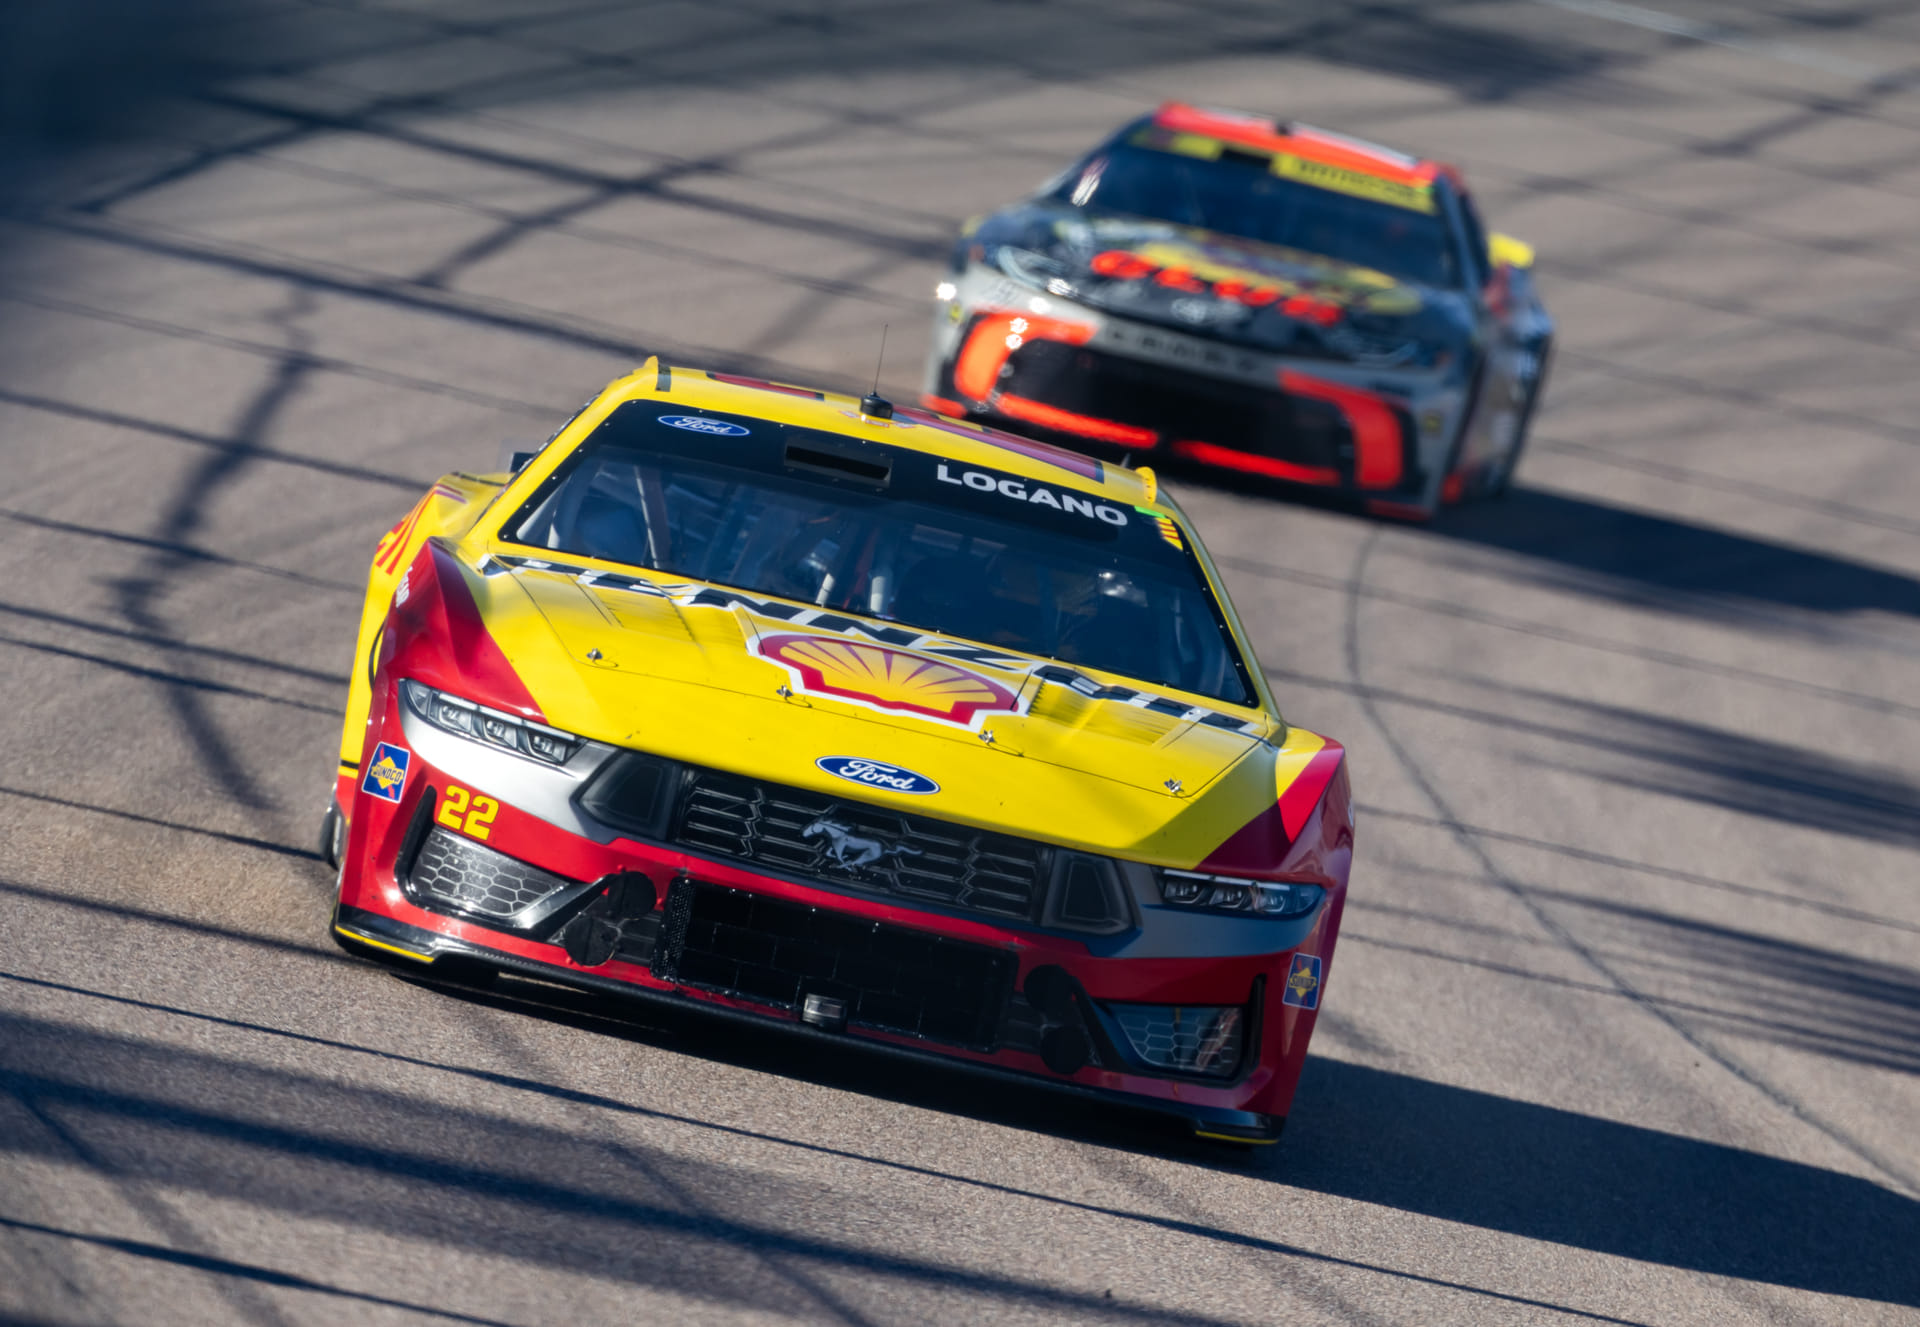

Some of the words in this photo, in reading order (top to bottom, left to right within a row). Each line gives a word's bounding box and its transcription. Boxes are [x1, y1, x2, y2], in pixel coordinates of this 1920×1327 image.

[674, 417, 732, 433] Ford
[937, 463, 1128, 526] LOGANO
[373, 763, 403, 783] SUNOCO
[839, 760, 916, 790] Ford
[437, 785, 500, 840] 22
